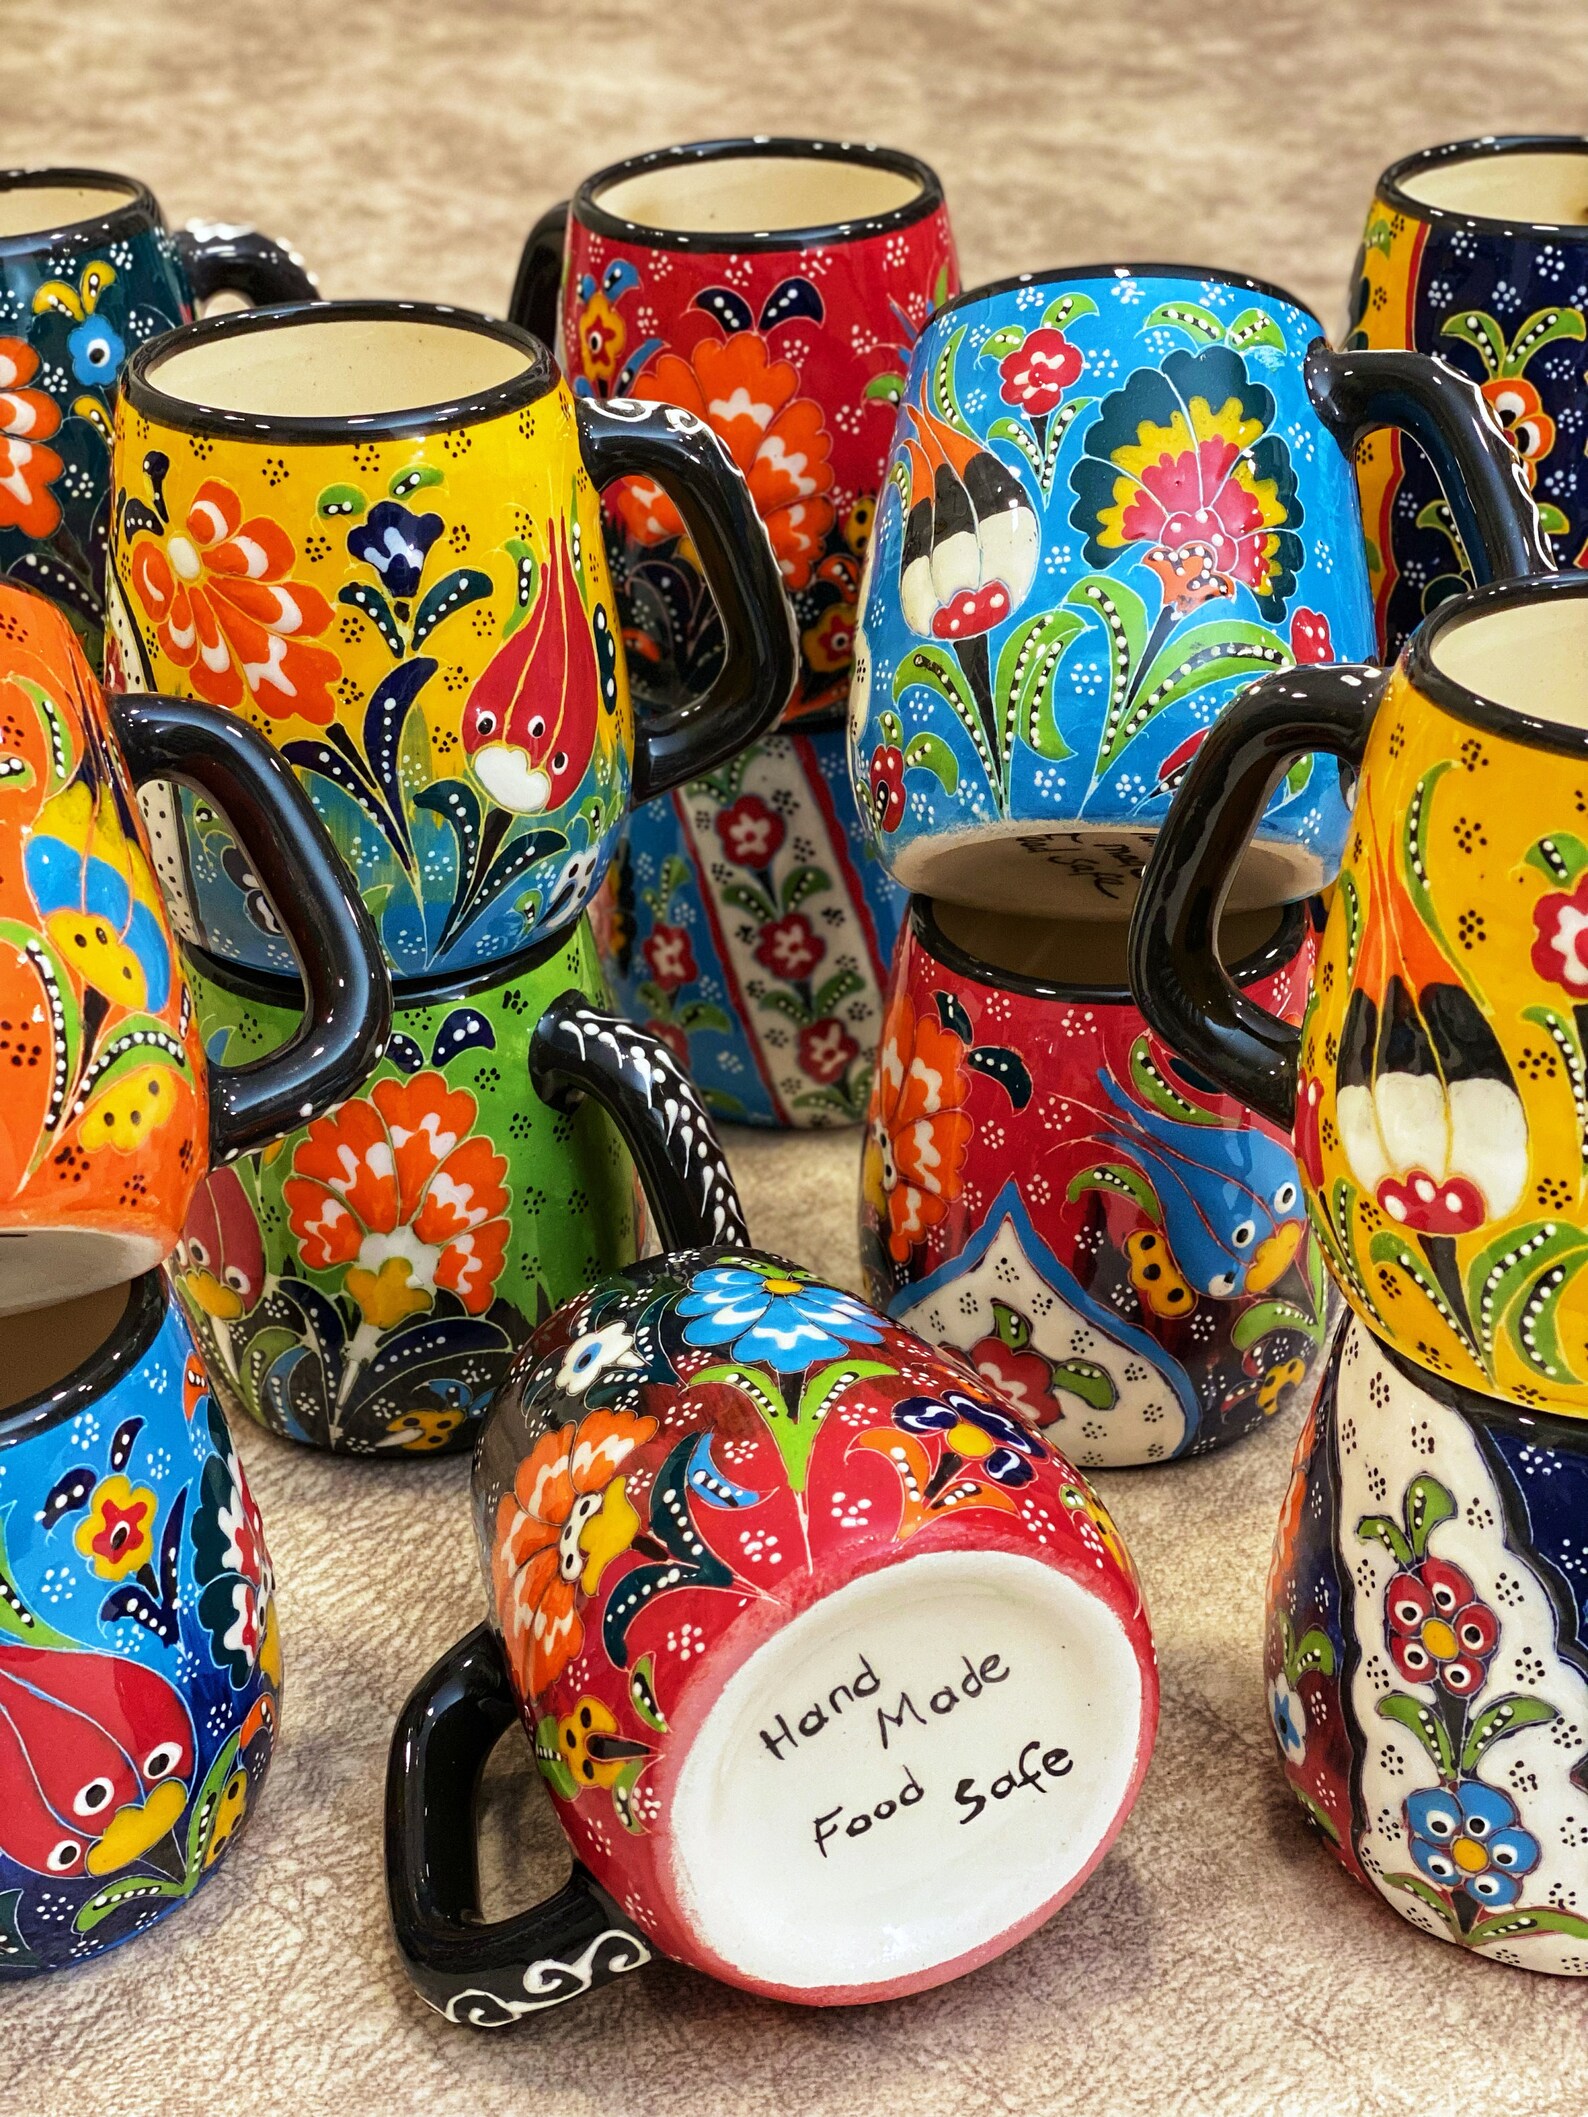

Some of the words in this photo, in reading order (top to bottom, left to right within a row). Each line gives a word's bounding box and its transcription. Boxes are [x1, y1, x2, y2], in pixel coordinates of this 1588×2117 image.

[759, 1653, 881, 1761] Hand
[877, 1653, 1011, 1750] Made
[812, 1764, 925, 1859] Food
